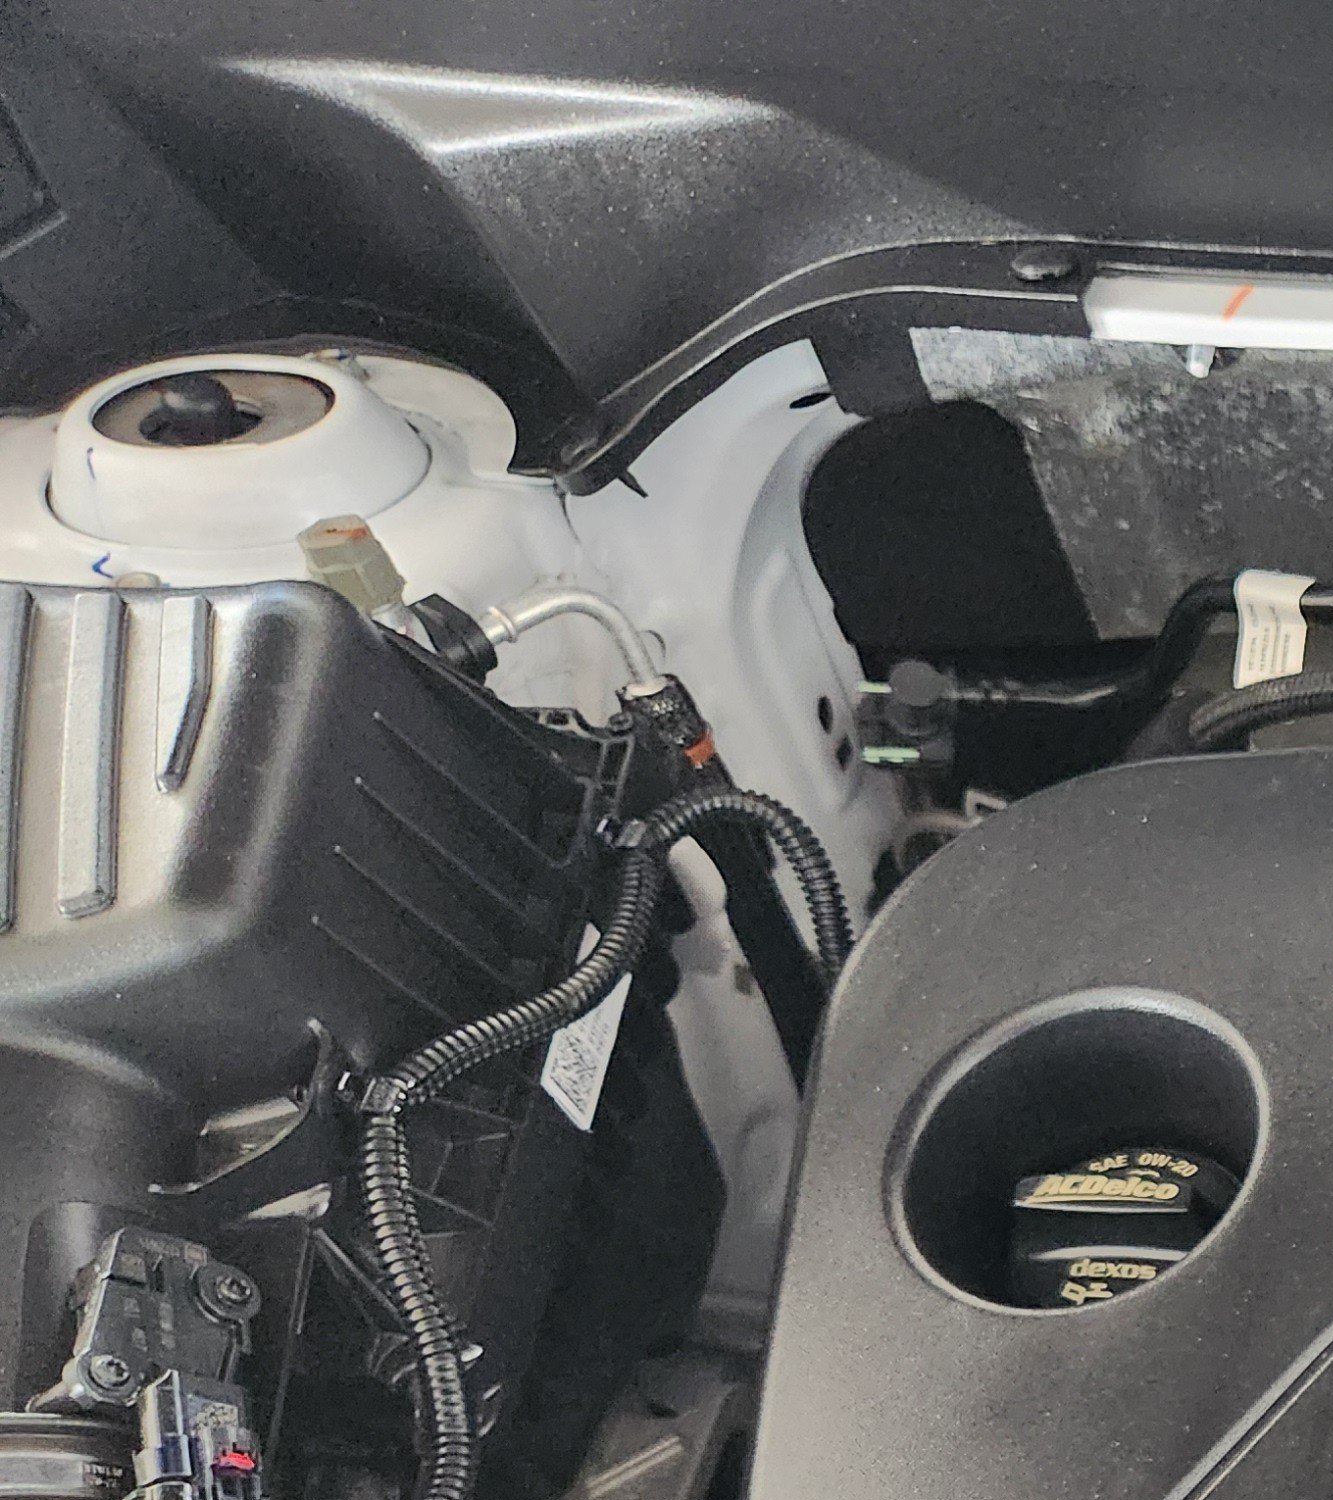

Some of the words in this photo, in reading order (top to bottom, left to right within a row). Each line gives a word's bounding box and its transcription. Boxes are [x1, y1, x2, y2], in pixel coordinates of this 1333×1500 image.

[1088, 1155, 1129, 1173] SAE
[1030, 1174, 1181, 1201] ACDelco
[1068, 1258, 1158, 1280] dexos
